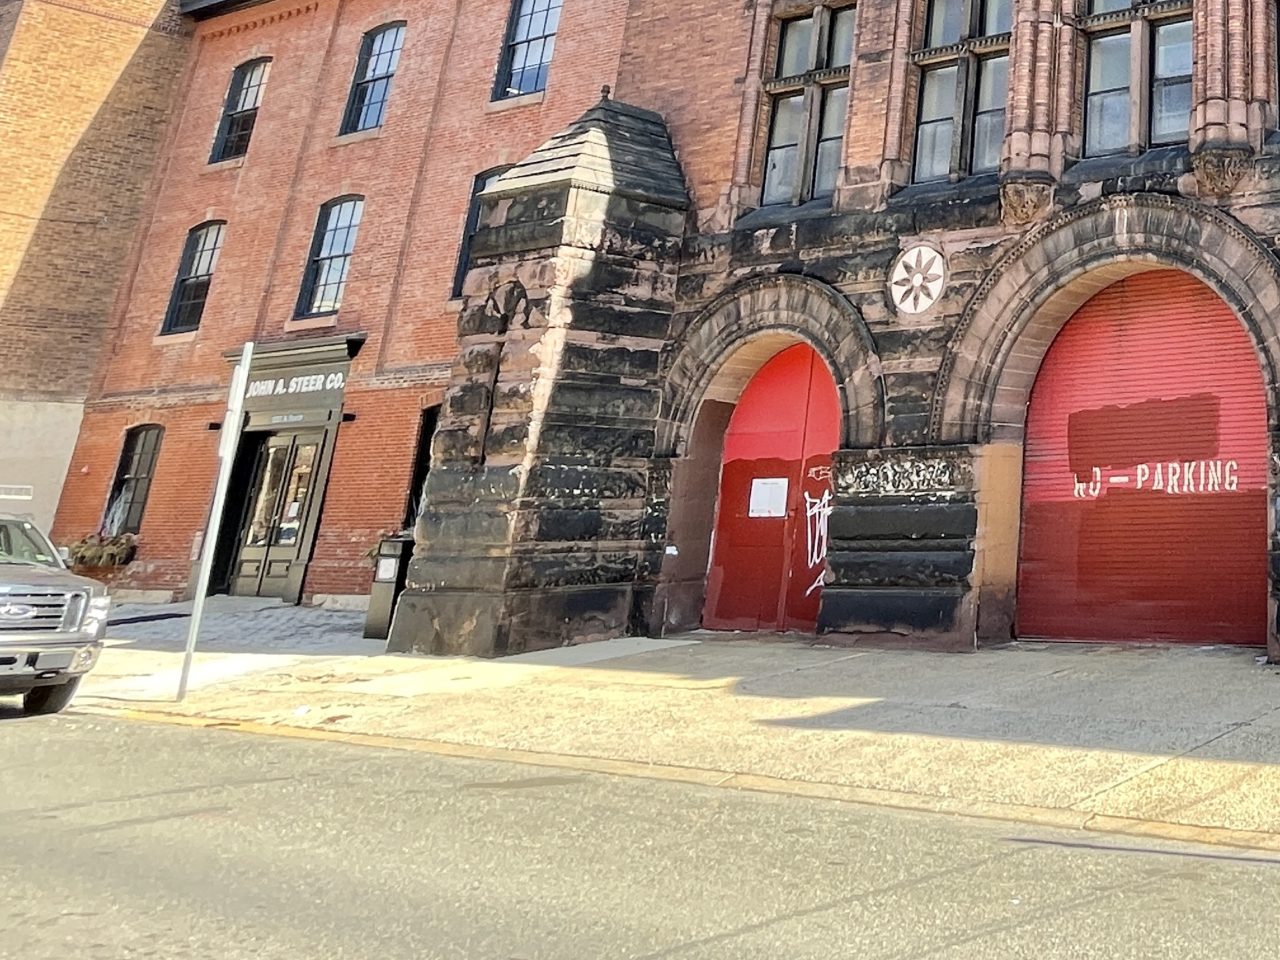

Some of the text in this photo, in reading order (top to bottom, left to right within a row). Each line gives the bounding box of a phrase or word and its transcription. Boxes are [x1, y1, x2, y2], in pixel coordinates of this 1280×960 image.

[246, 372, 346, 398] JOHN A. STEER CO.
[1136, 459, 1239, 495] PARKING
